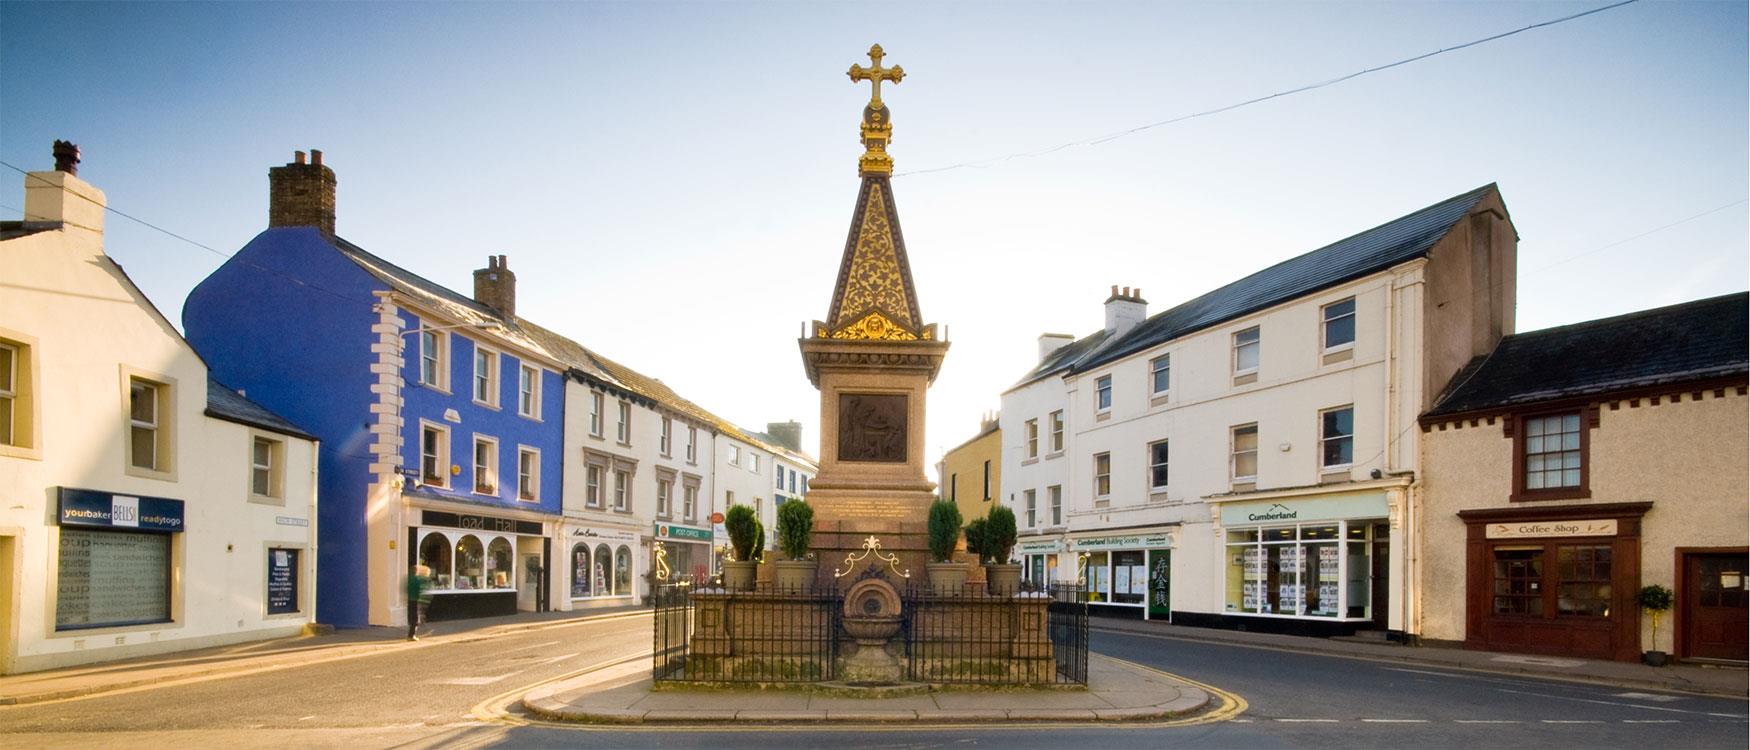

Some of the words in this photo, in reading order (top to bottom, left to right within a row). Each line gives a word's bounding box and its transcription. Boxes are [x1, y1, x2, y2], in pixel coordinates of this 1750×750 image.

[64, 509, 111, 519] yourbaker
[1248, 511, 1297, 521] Cumberland
[141, 515, 181, 526] readytogo
[495, 518, 517, 532] Hall
[686, 530, 699, 538] OFFICE
[1519, 525, 1551, 534] Coffee
[1554, 524, 1580, 534] Shop
[1077, 538, 1106, 546] Cumberland
[1106, 537, 1123, 546] Building
[1123, 536, 1140, 545] Society
